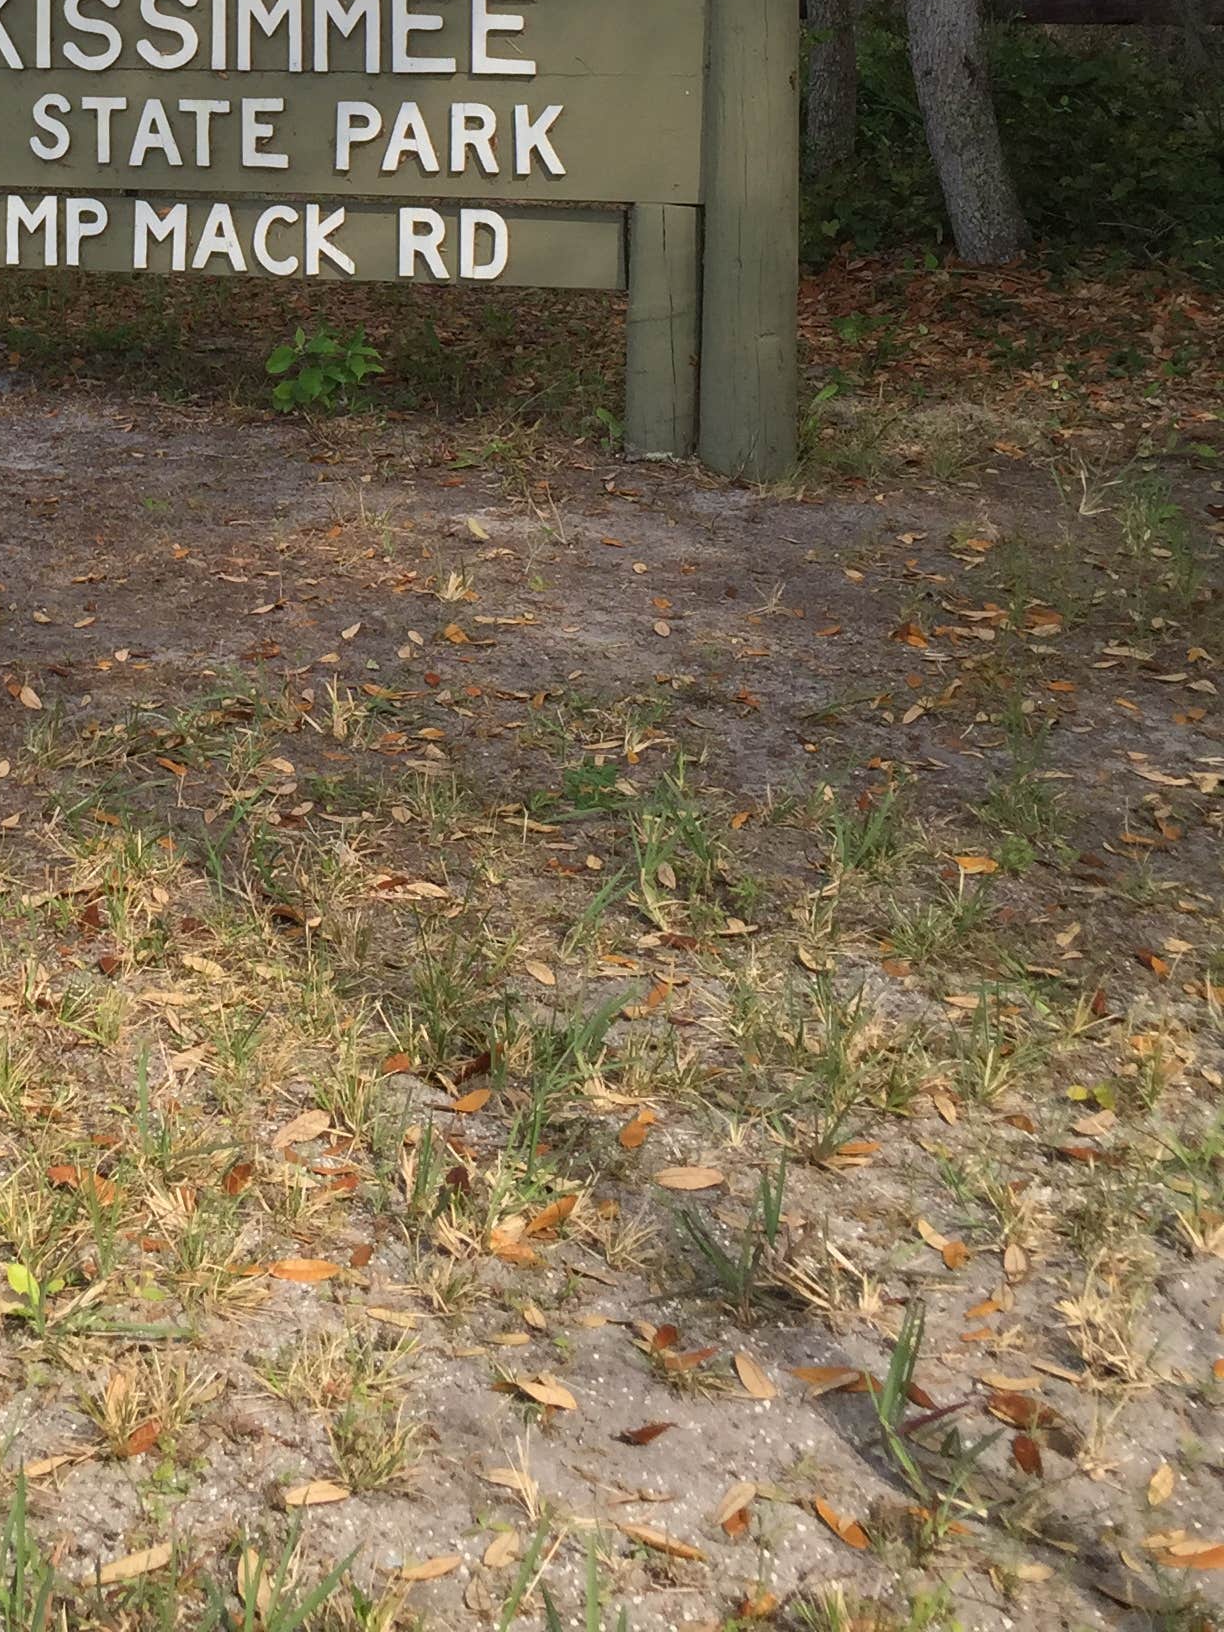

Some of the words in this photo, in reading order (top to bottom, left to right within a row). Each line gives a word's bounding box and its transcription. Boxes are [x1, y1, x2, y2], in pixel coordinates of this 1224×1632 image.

[29, 94, 289, 169] STATE
[335, 101, 567, 175] PARK
[133, 199, 356, 276] MACK
[399, 207, 509, 280] RD
